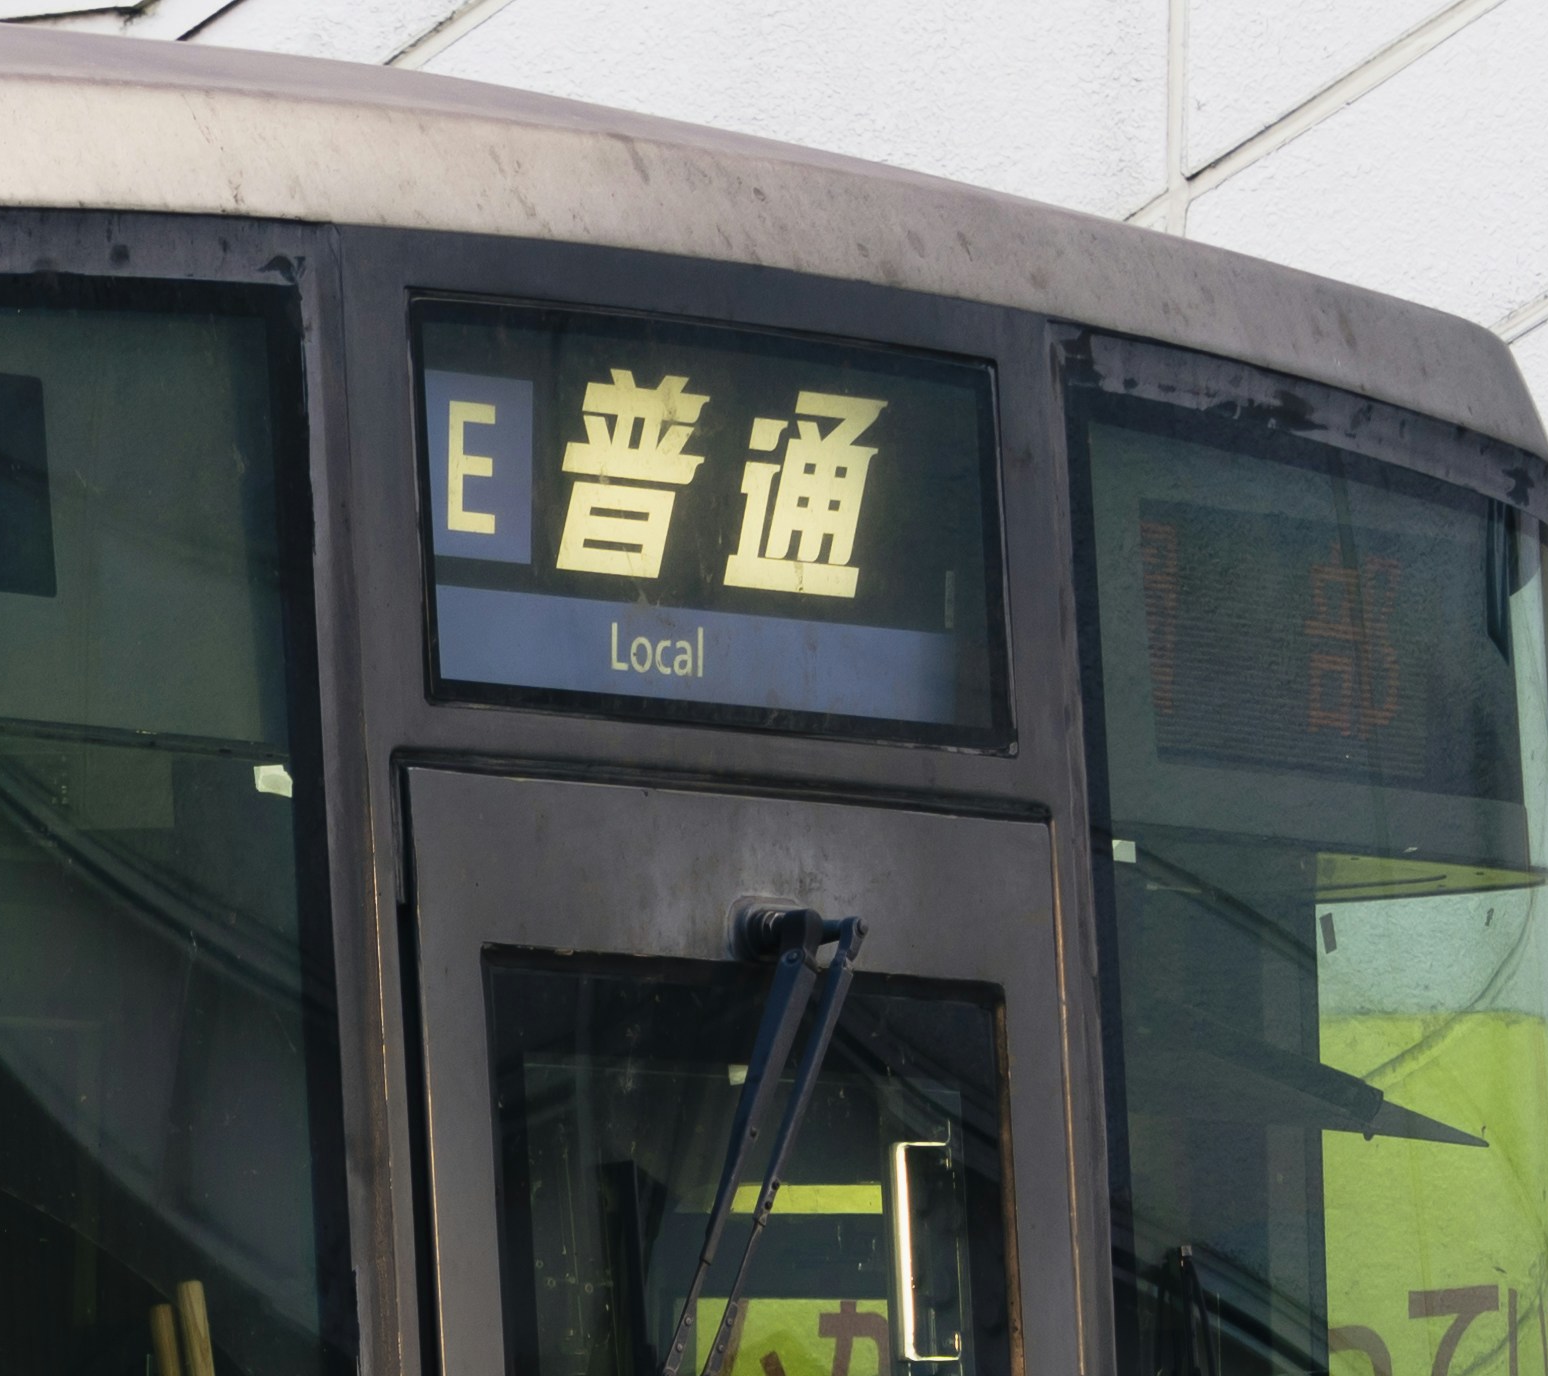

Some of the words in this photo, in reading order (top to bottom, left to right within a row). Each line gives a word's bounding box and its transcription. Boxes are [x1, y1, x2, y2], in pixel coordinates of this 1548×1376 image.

[446, 400, 498, 534] E
[556, 368, 889, 600] 普通
[610, 621, 705, 678] Local
